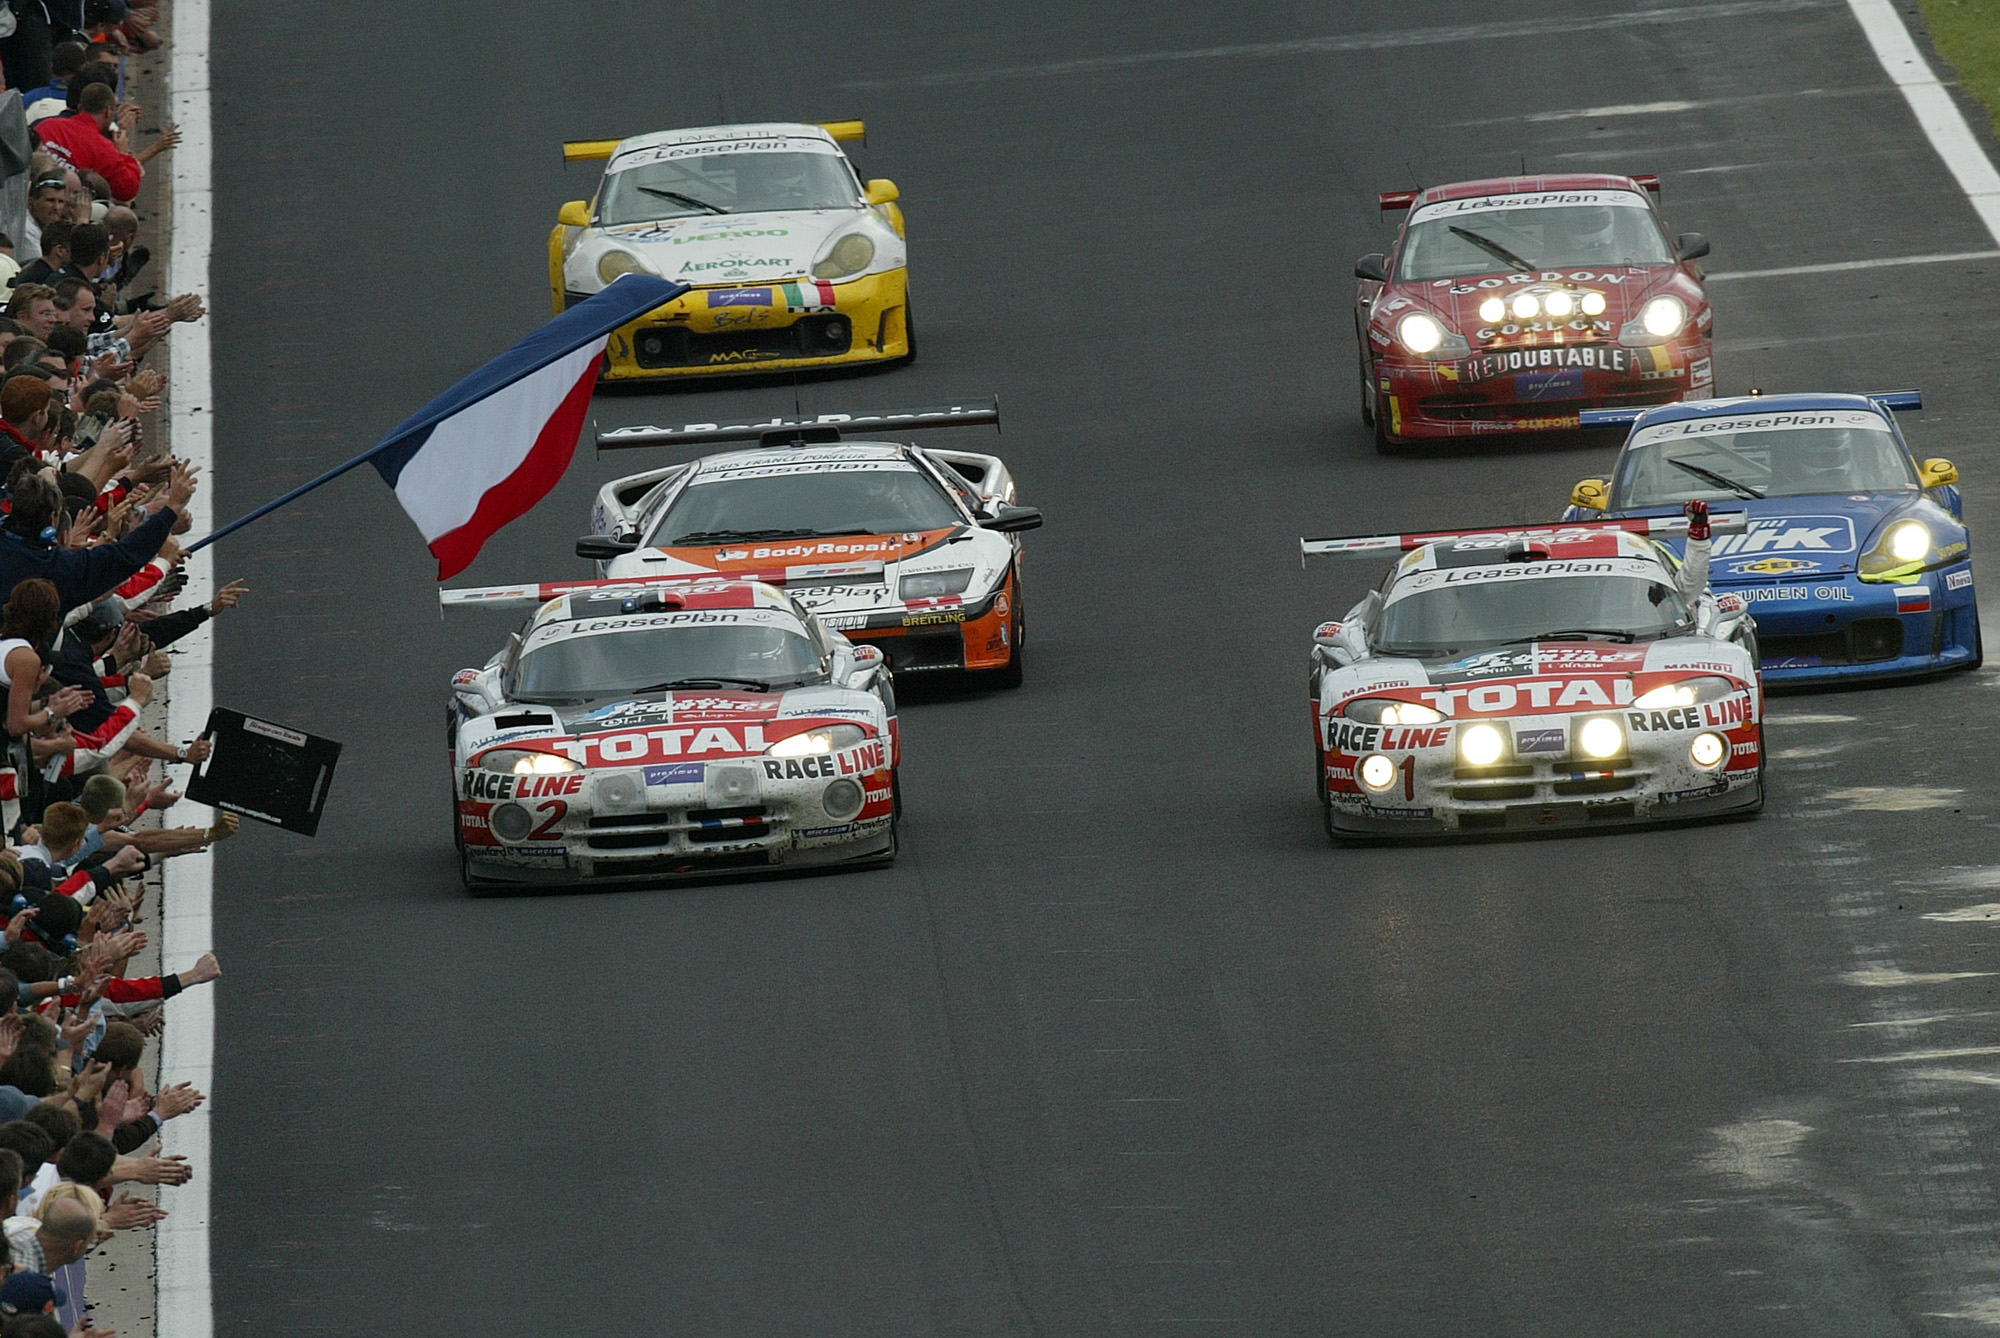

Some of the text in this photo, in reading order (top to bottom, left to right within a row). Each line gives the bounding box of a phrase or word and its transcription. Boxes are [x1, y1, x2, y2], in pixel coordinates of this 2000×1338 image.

[654, 141, 787, 160] LeasePlan
[1456, 192, 1598, 211] LeasePlan
[679, 258, 793, 274] AEROKART
[1449, 271, 1626, 294] GORDON
[1466, 347, 1625, 382] REDOUBTABLE
[1683, 413, 1834, 435] LeasePlan
[719, 463, 879, 479] LeasePlan
[1445, 562, 1613, 583] LeasePlan
[790, 585, 890, 598] sePlan
[1814, 586, 1855, 601] OIL
[571, 613, 739, 634] LeasePlan
[902, 613, 966, 627] BREITLING
[1421, 679, 1637, 716] TOTAL
[1627, 696, 1753, 732] RACE LINE
[1327, 718, 1452, 751] RACE LINE
[1521, 735, 1563, 744] proximus
[553, 725, 776, 766] TOTAL
[1732, 740, 1759, 755] TOTAL
[762, 742, 886, 780] RACE LINE
[1326, 765, 1354, 780] TOTAL
[1399, 754, 1415, 801] 1
[462, 770, 586, 800] RACE LINE
[866, 788, 893, 804] TOTAL
[461, 813, 488, 829] TOTAL
[527, 799, 568, 841] 2
